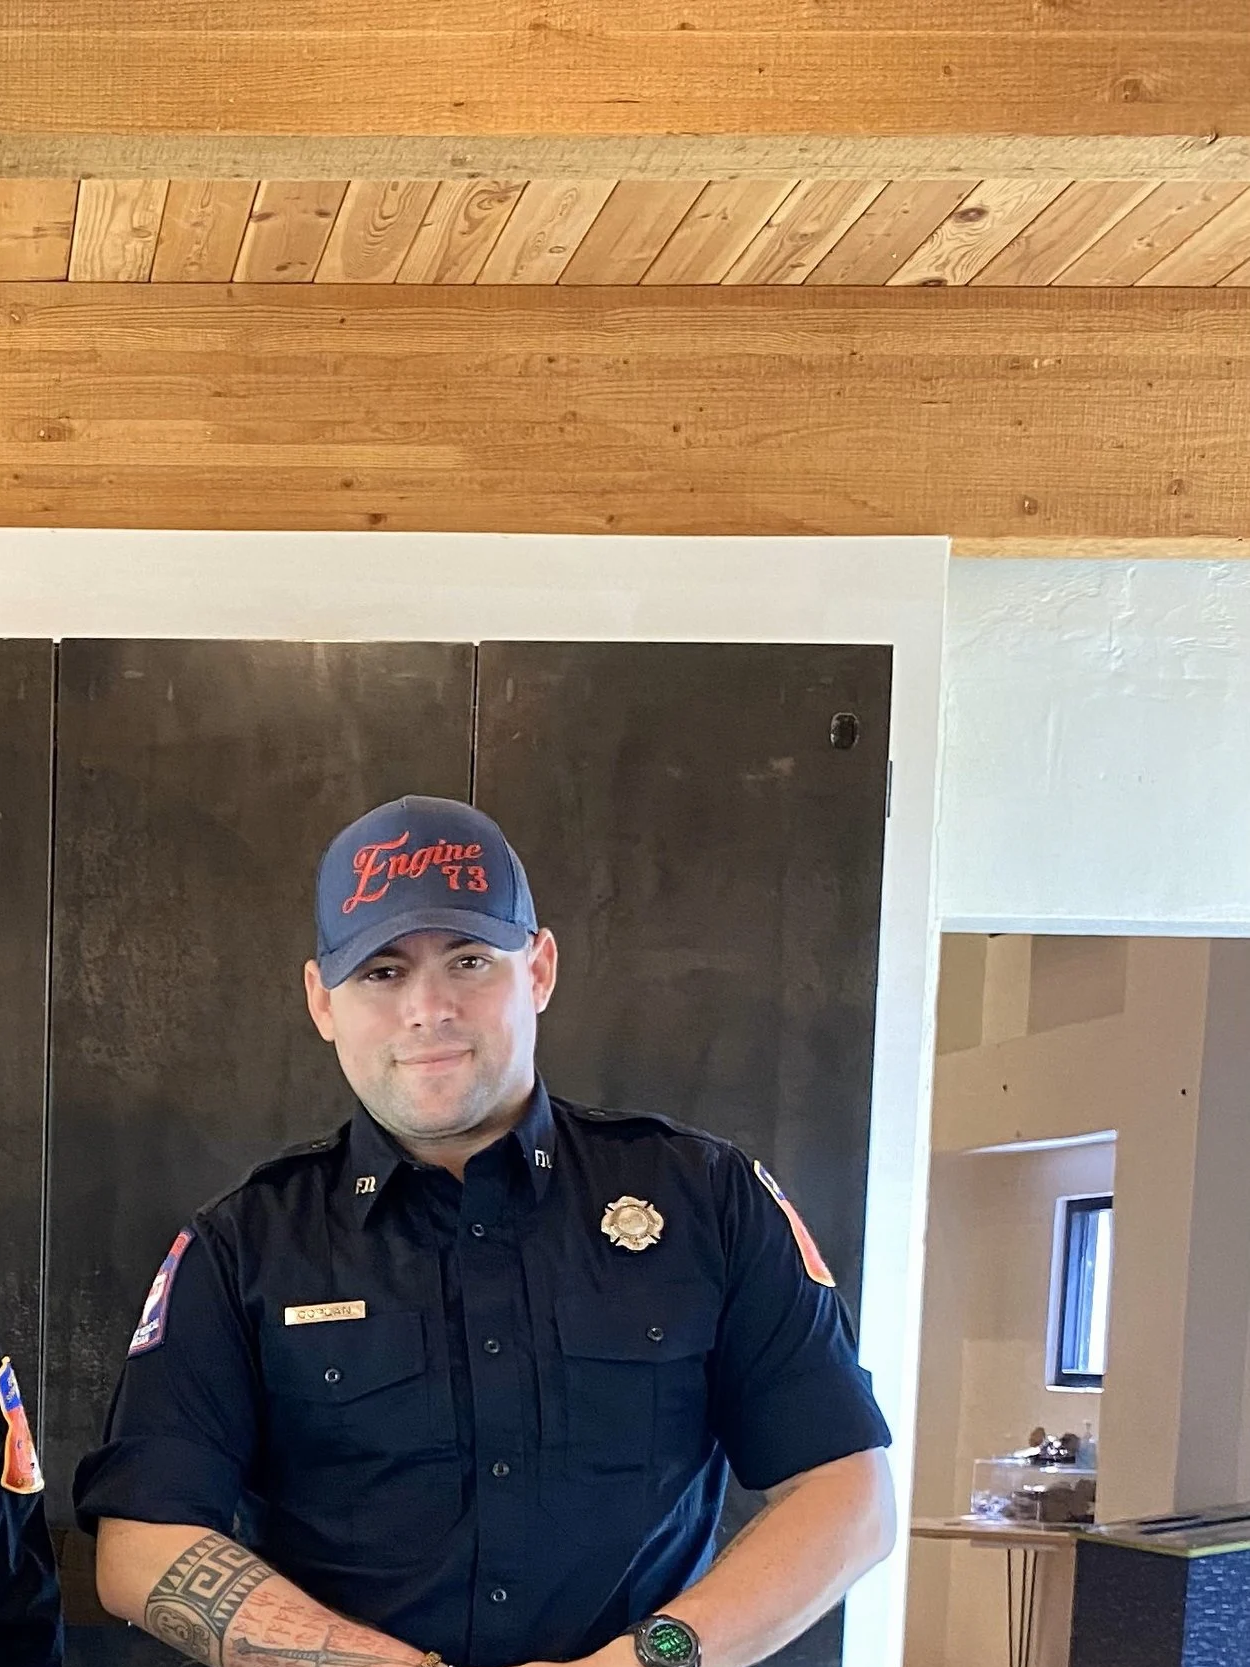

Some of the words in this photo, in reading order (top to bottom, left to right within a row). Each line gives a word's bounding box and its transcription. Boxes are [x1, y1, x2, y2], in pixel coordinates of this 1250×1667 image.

[342, 830, 484, 914] Engine
[441, 865, 489, 893] 73
[355, 1176, 376, 1195] FD
